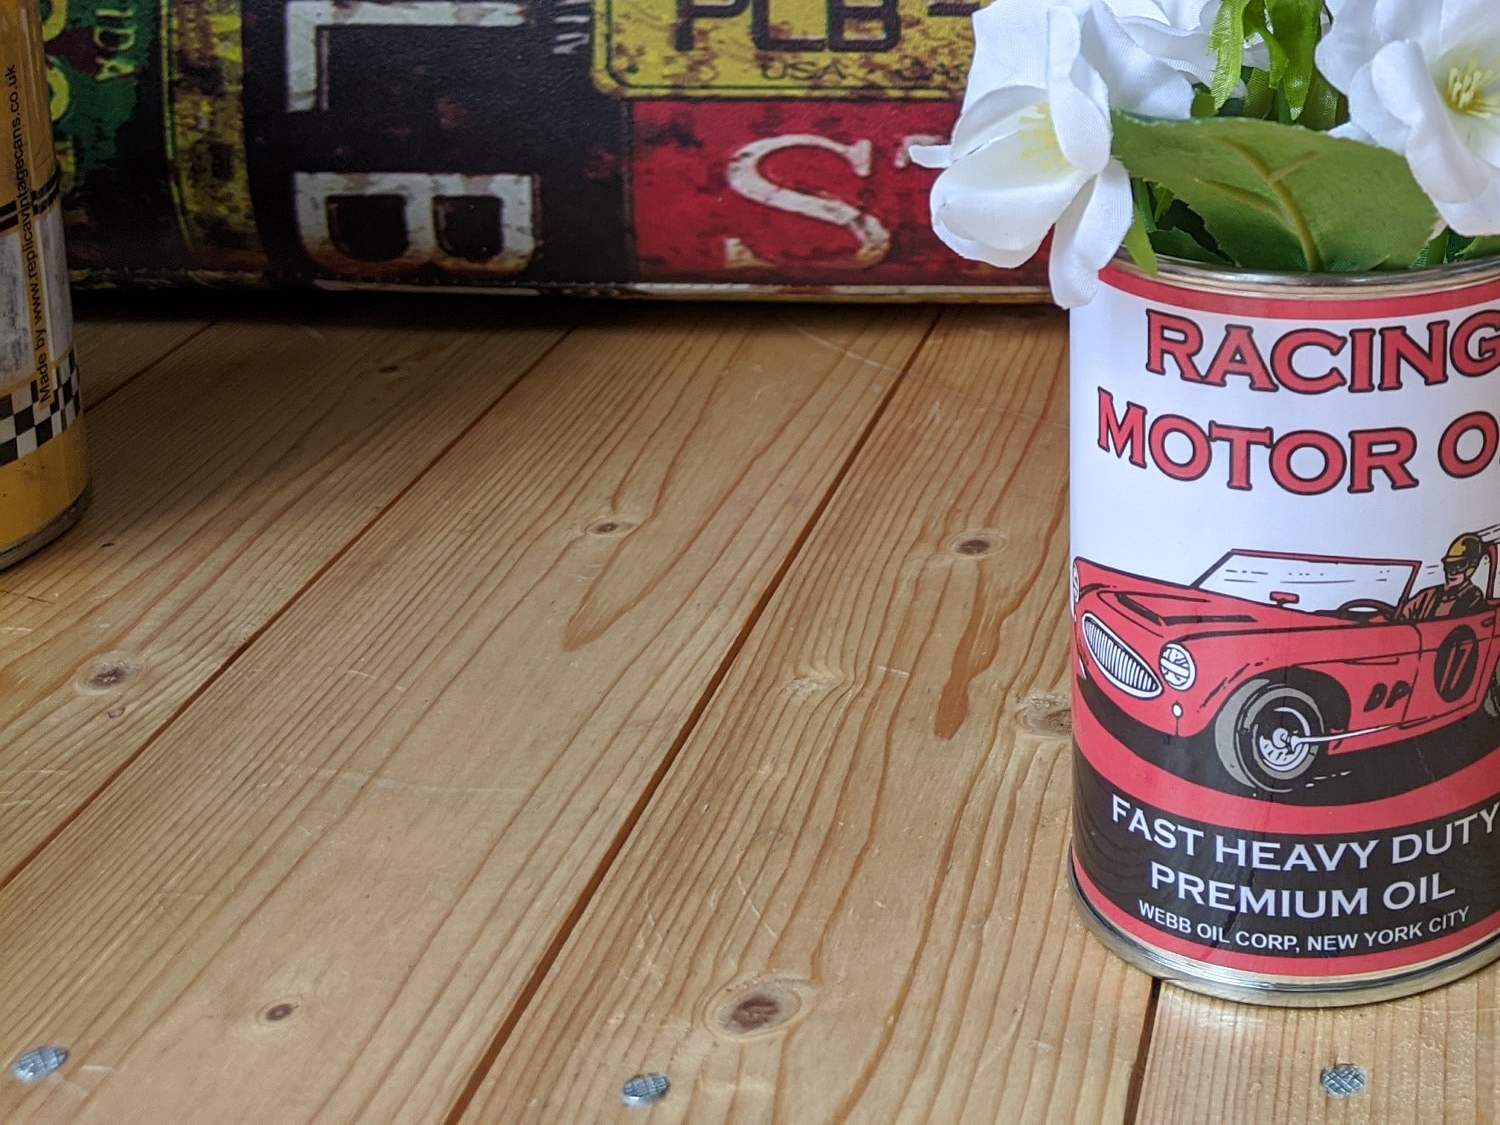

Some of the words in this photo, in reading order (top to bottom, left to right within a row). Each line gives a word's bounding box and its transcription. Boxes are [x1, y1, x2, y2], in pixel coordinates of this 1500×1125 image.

[33, 328, 47, 351] by
[35, 352, 54, 404] Made
[1097, 386, 1419, 496] MOTOR
[1440, 639, 1475, 693] 17
[1111, 793, 1205, 858] FAST
[1215, 834, 1381, 873] HEAVY
[1149, 860, 1369, 920] PREMIUM
[1382, 872, 1457, 910] OIL
[1138, 899, 1192, 937] WEBB
[1196, 921, 1231, 945] OIL
[1306, 932, 1360, 953] NEW
[1362, 922, 1424, 948] YORK
[1428, 906, 1470, 935] CITY
